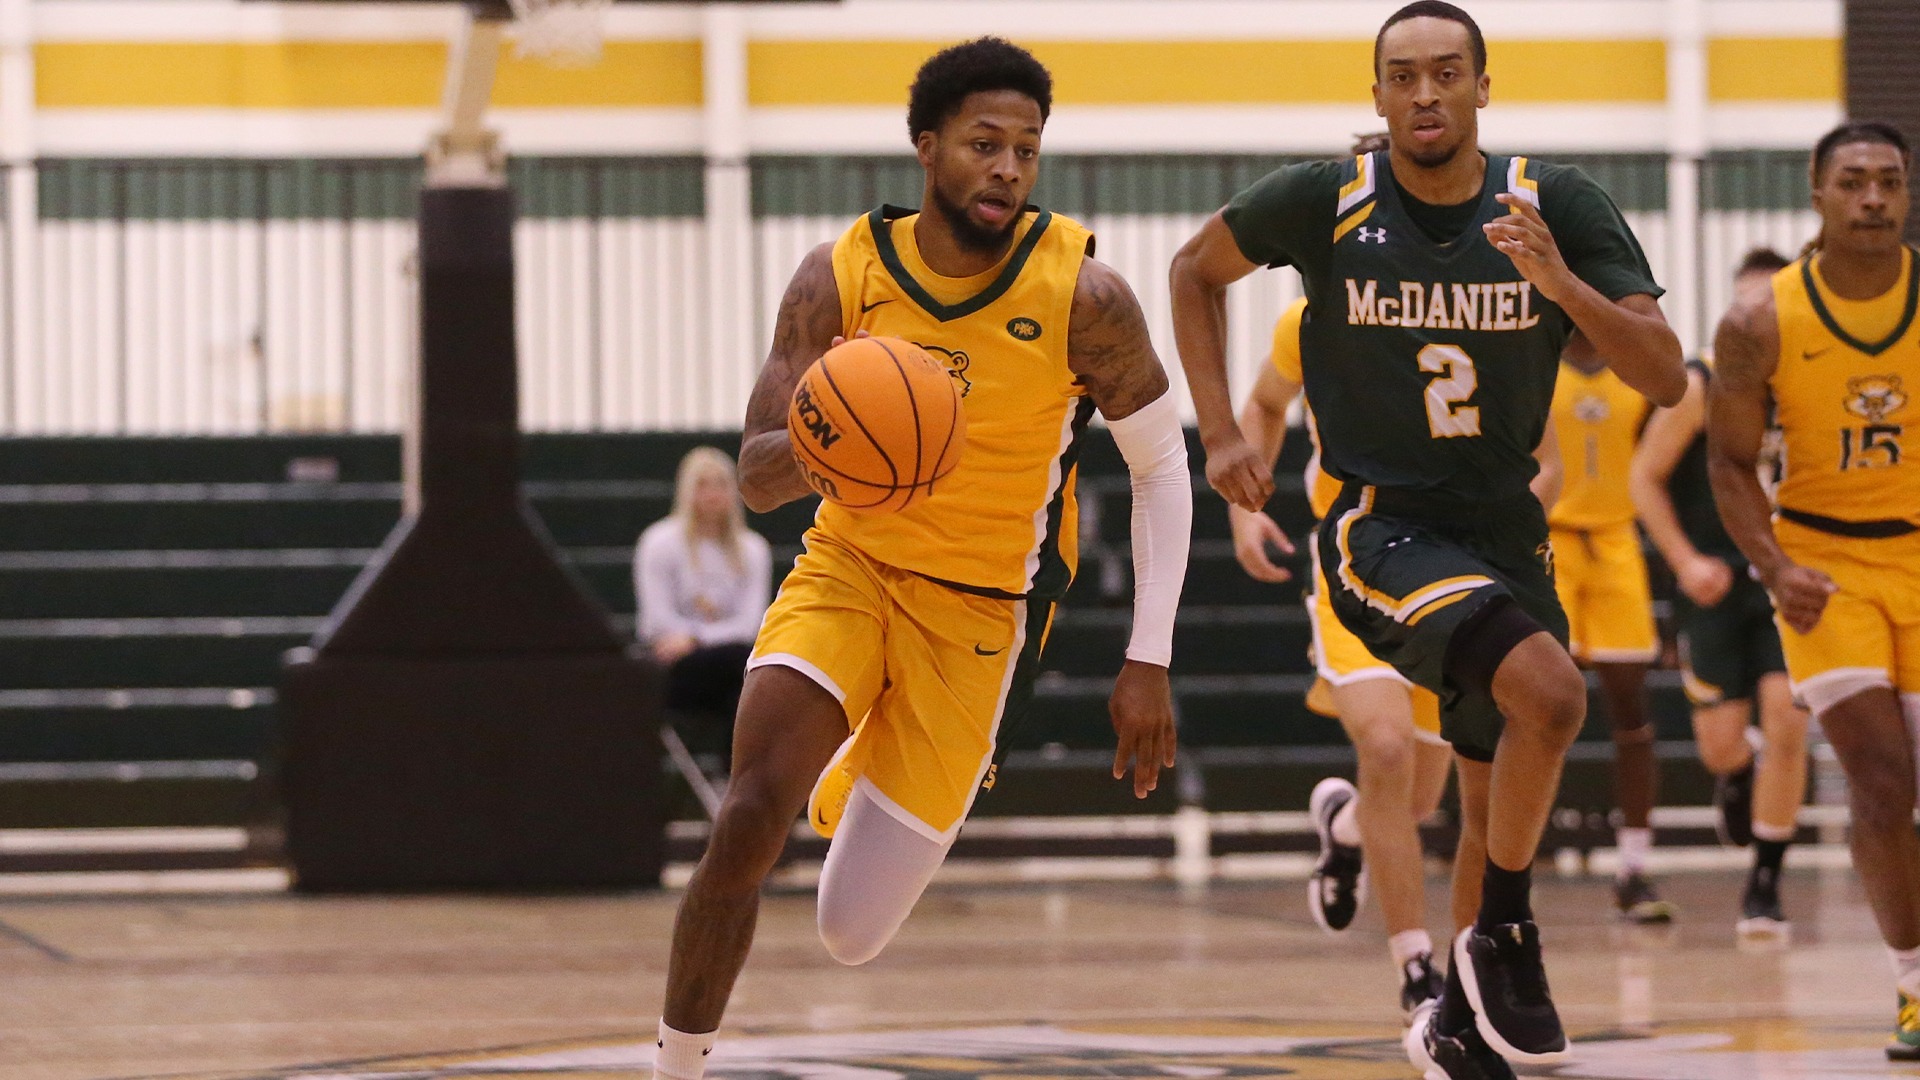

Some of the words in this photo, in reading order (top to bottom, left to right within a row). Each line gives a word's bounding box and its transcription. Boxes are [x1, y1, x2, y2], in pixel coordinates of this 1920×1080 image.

[1345, 278, 1540, 331] McDANIEL
[795, 380, 842, 451] NCAA
[1416, 342, 1482, 439] 2
[1839, 424, 1903, 471] 15
